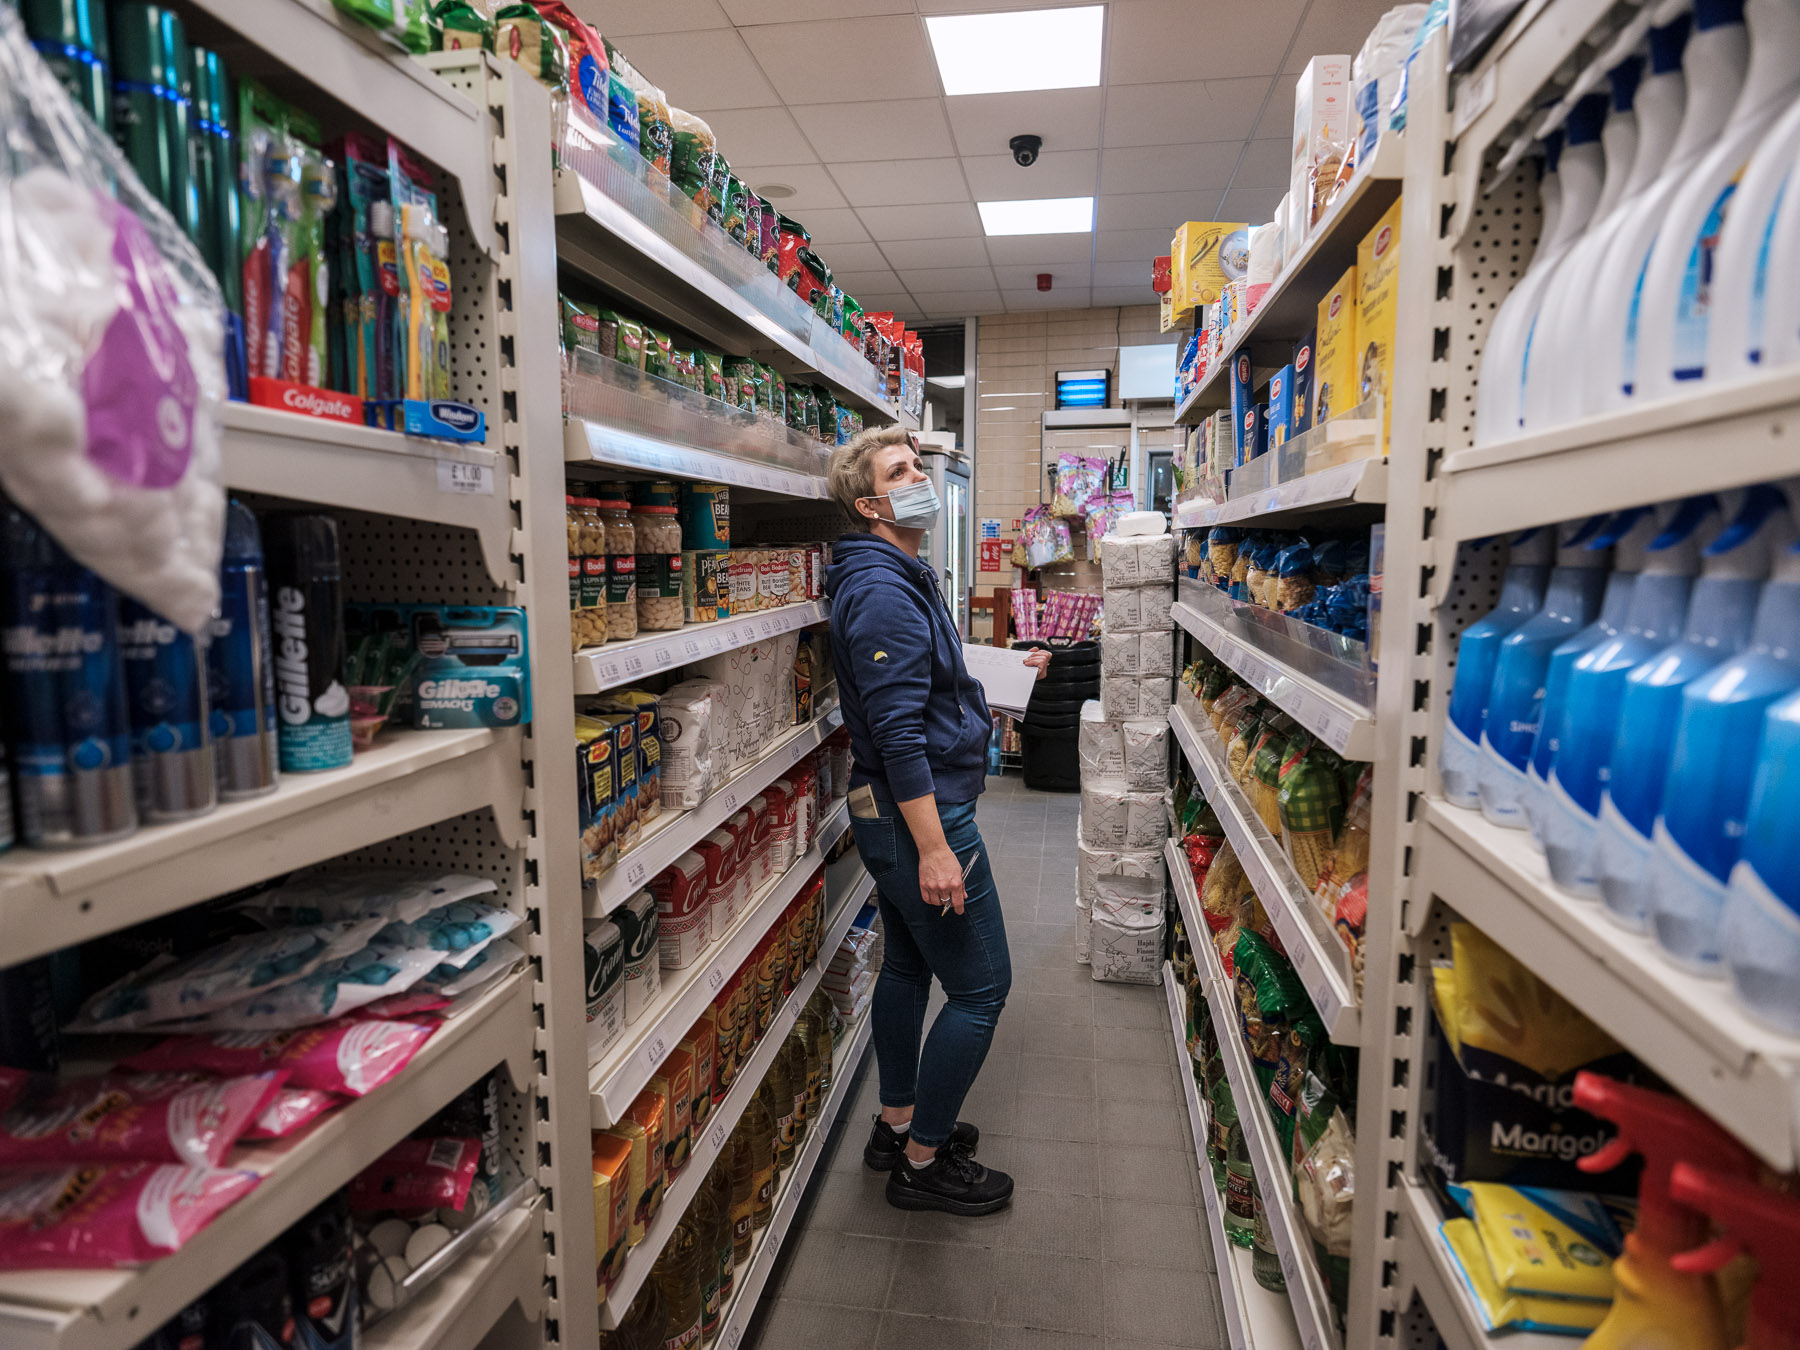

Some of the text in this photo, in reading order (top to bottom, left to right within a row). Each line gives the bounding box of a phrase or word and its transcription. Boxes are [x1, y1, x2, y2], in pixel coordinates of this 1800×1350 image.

[284, 300, 301, 383] olgate
[283, 389, 352, 418] Colgate
[439, 407, 475, 423] Wisdom
[274, 586, 311, 725] Gillette
[418, 680, 501, 699] Gillette
[1490, 1120, 1613, 1161] Marigol
